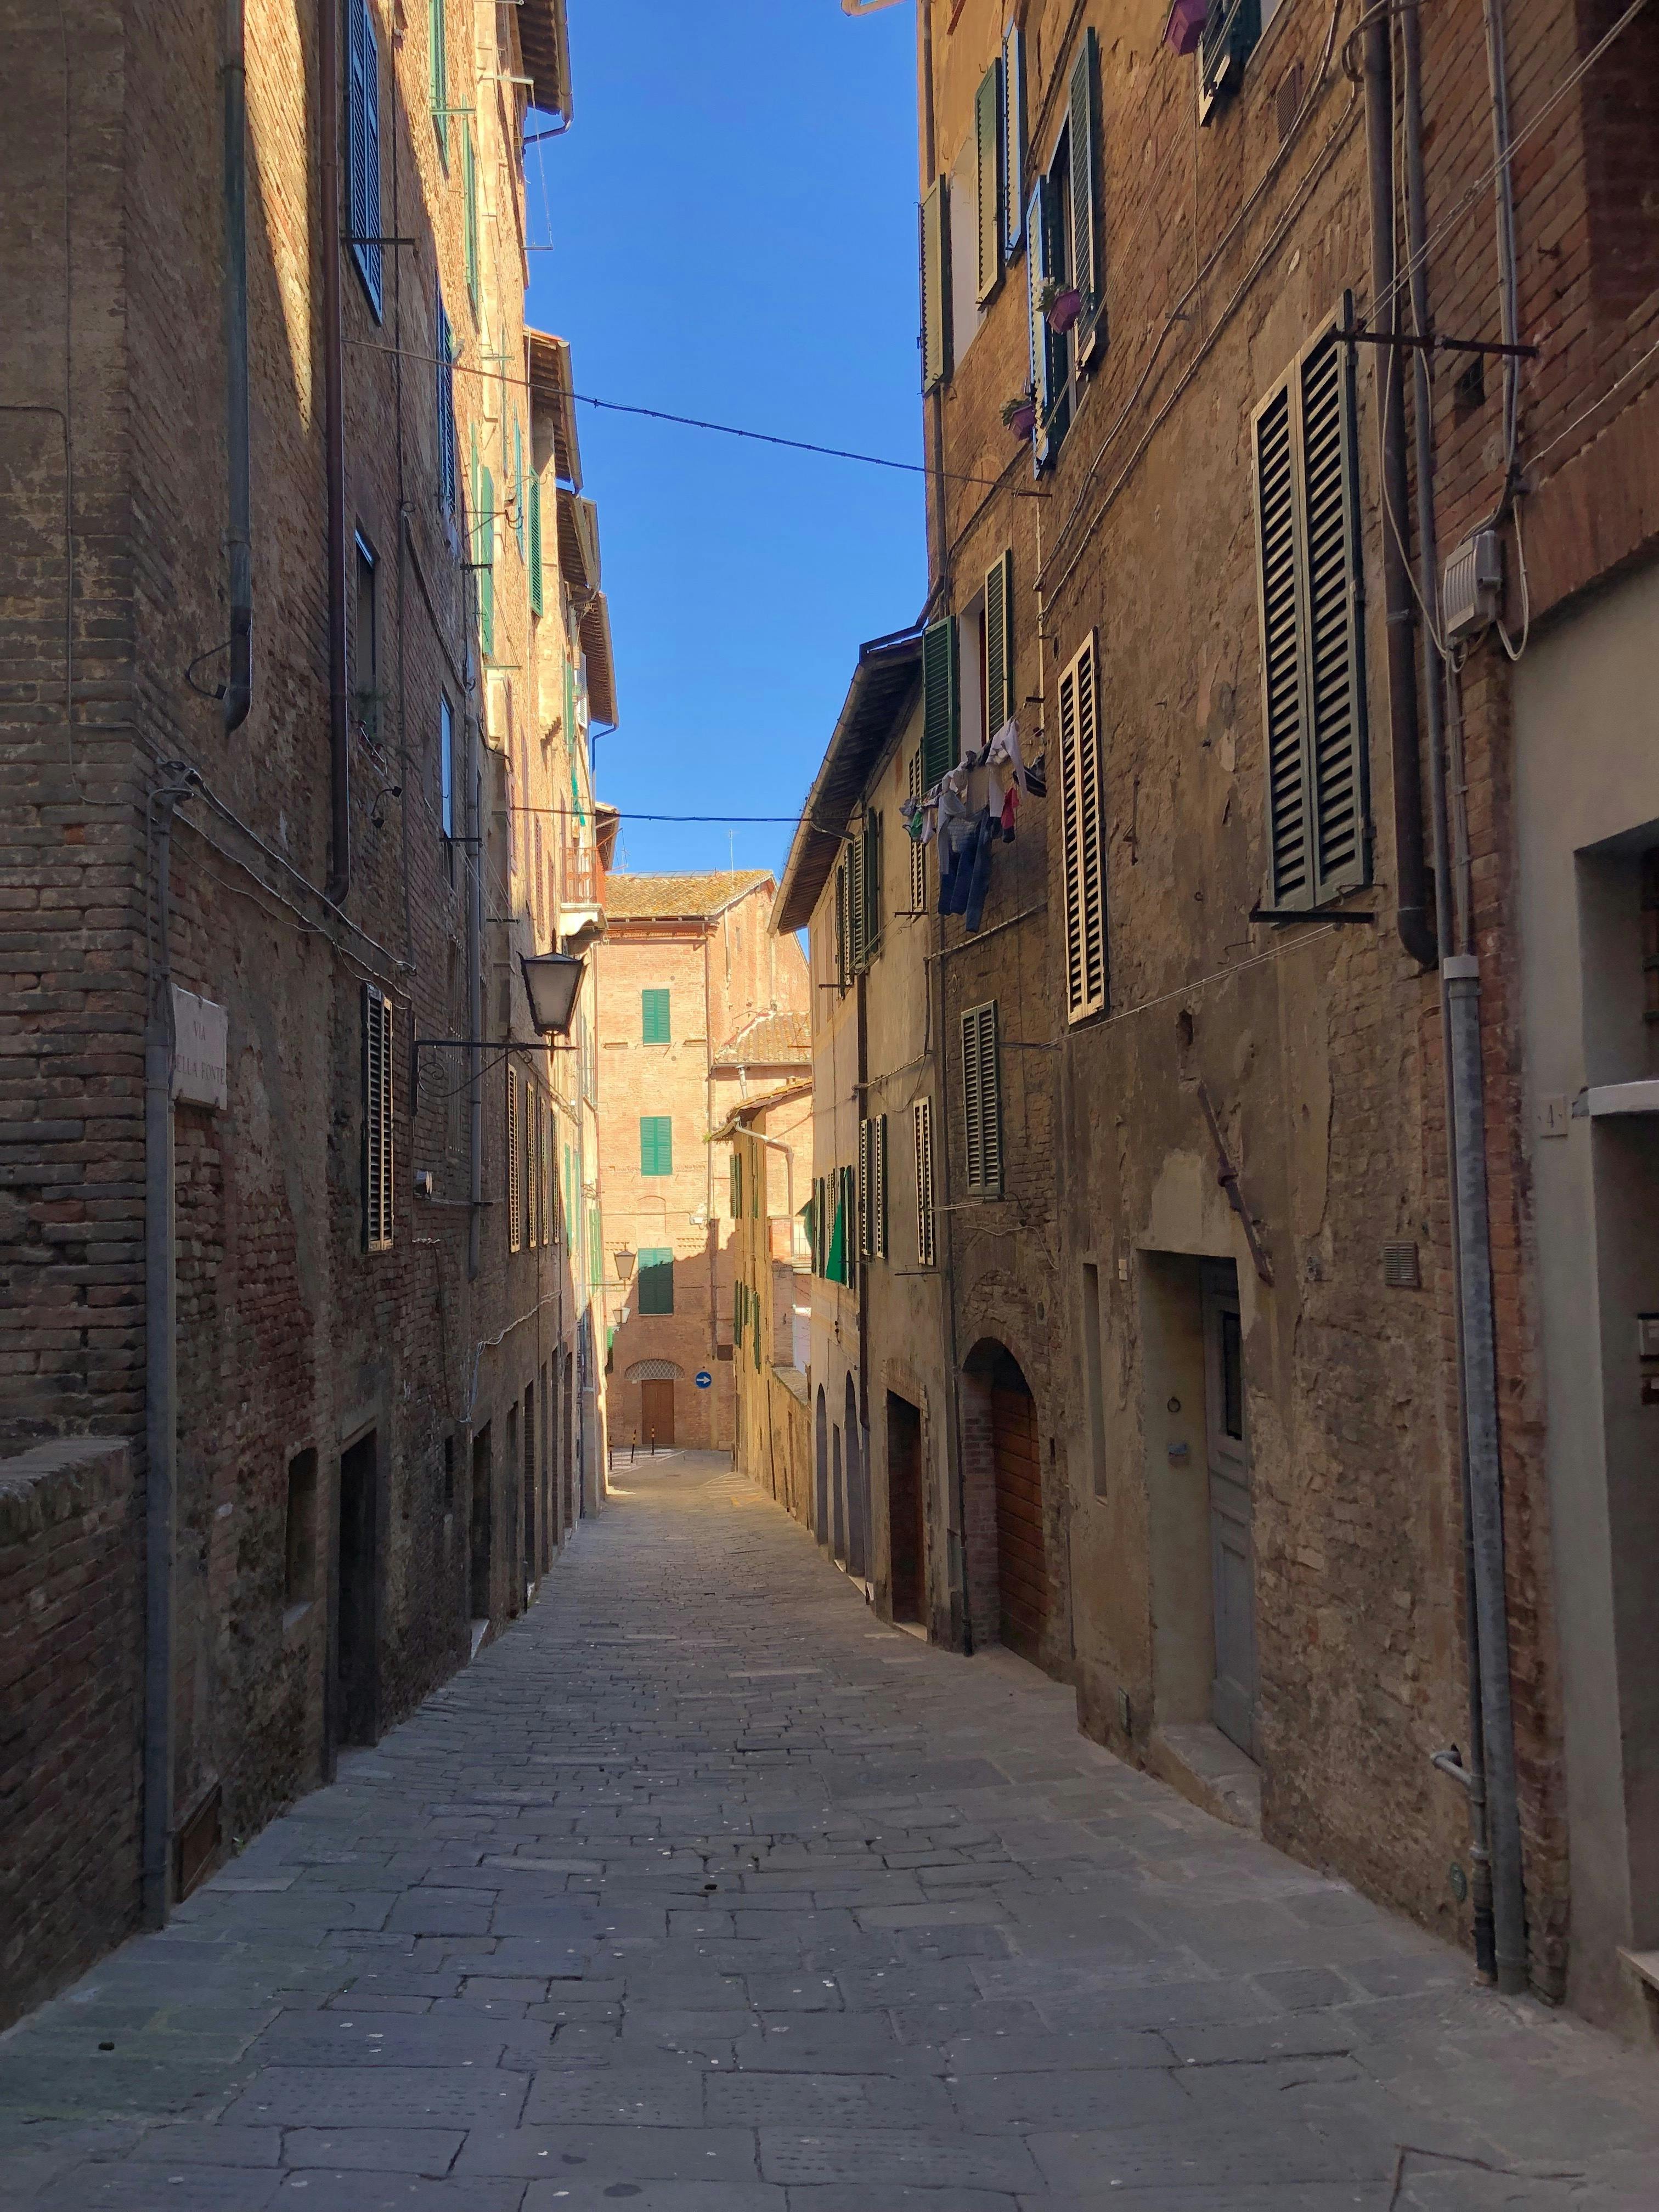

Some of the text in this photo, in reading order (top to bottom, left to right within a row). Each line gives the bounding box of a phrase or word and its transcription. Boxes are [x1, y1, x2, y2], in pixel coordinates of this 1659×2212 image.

[193, 1020, 206, 1041] VIA
[173, 1053, 224, 1085] ELLA FONTE
